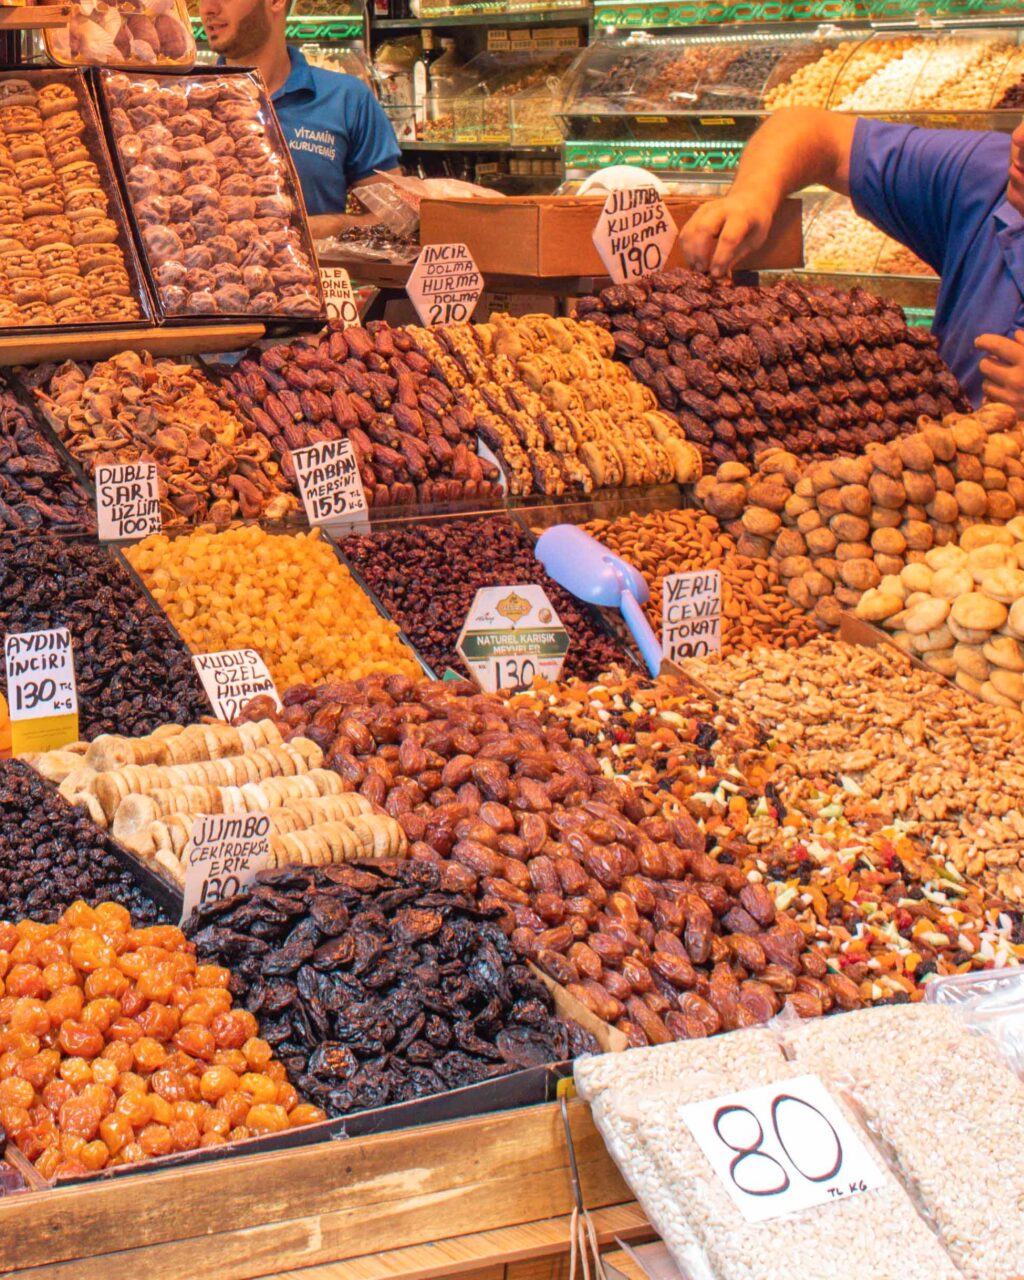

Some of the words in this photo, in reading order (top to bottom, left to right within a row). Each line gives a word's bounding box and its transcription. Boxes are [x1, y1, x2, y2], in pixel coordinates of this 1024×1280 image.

[608, 204, 665, 237] KUDÜS
[611, 221, 668, 255] HURMA
[426, 262, 473, 275] DOLMA
[620, 243, 662, 279] 190
[422, 274, 479, 293] HURMA
[433, 292, 479, 304] DOLMA
[429, 304, 468, 325] 210
[292, 440, 349, 470] TANE
[99, 465, 156, 486] DUBLE
[300, 454, 356, 488] YABAN
[101, 482, 153, 507] SARI
[313, 491, 346, 518] 155
[111, 499, 161, 522] ÜZÜM
[119, 518, 147, 536] 100
[666, 574, 718, 602] YERLİ
[668, 596, 719, 624] CEVİZ
[477, 634, 519, 646] NATUREL
[520, 633, 556, 645] KARIŞIK
[666, 618, 720, 641] TOKAT
[7, 631, 70, 656] AYDIN
[9, 650, 67, 677] İNCİRİ
[197, 650, 257, 670] KUDUS
[214, 665, 265, 684] ÖZEL
[496, 659, 536, 691] 130
[16, 678, 57, 710] 130
[217, 679, 273, 699] HURMA
[193, 816, 270, 846] JUMBO
[712, 1093, 843, 1197] 80
[827, 1187, 843, 1198] TL
[849, 1179, 868, 1193] KG
